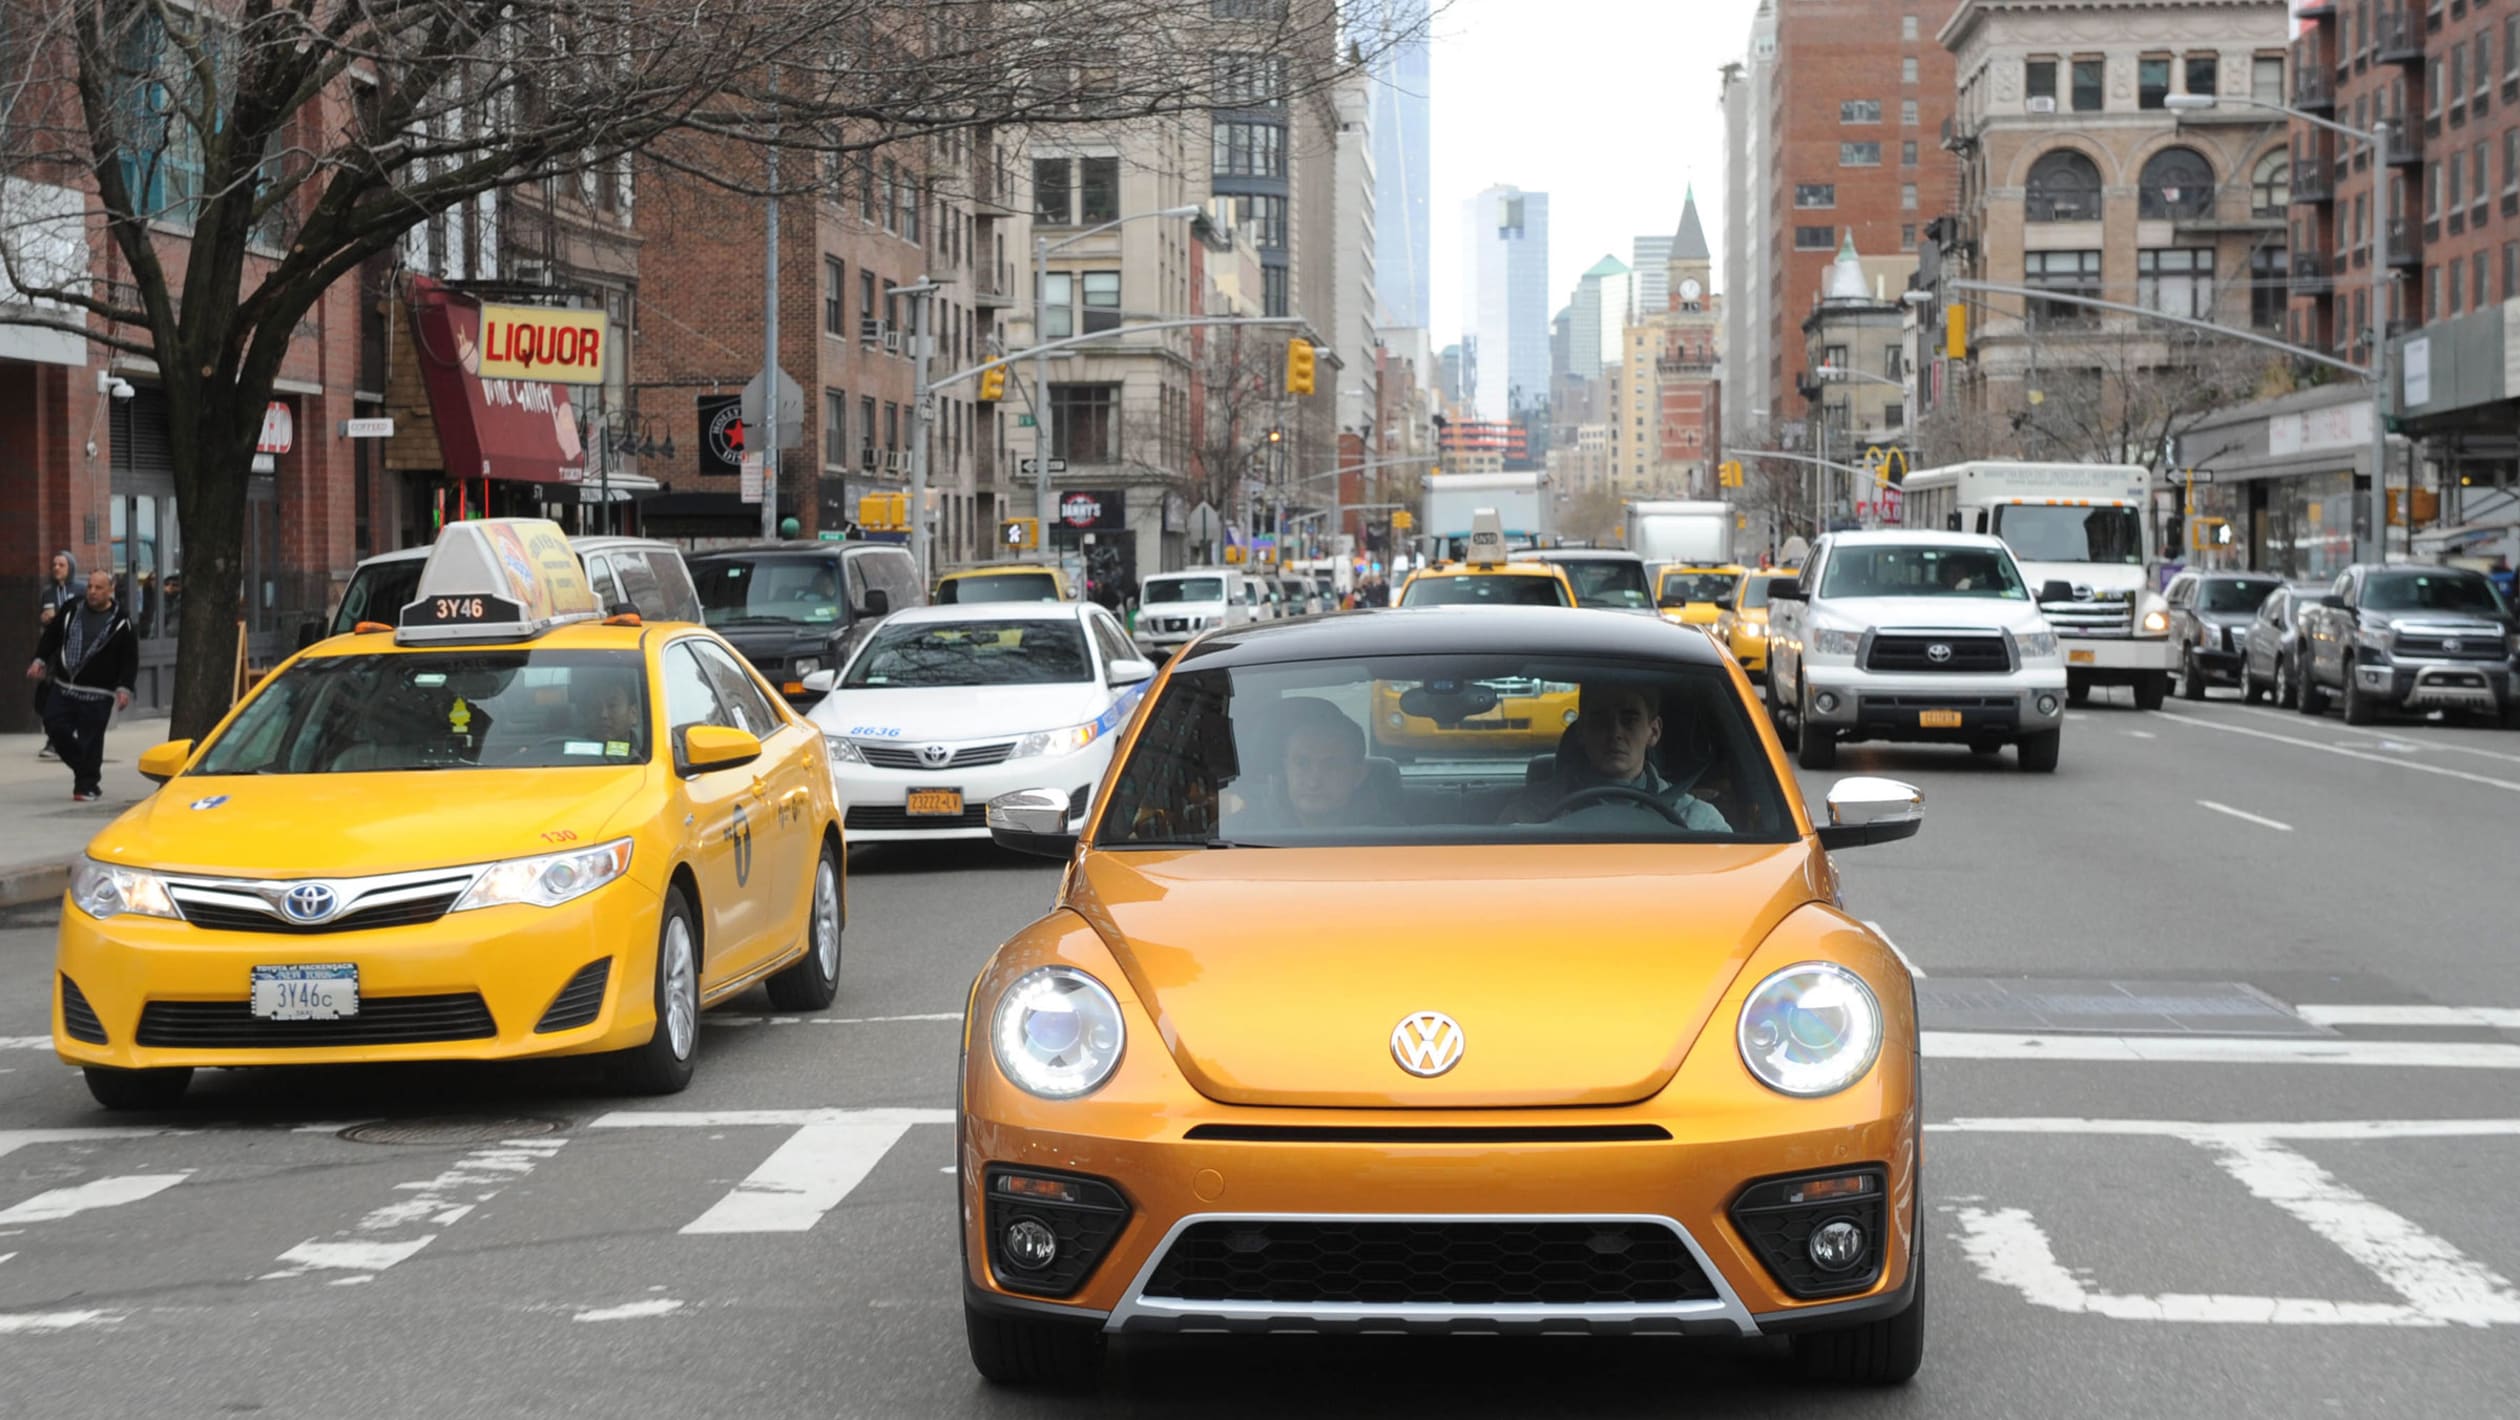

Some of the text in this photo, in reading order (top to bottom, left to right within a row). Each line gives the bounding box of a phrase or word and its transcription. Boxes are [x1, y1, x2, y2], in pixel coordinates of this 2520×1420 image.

[486, 321, 600, 368] LIQUOR
[436, 599, 483, 618] 3Y46
[850, 726, 901, 737] 8636
[541, 831, 577, 843] 130
[1392, 1011, 1463, 1076] VW
